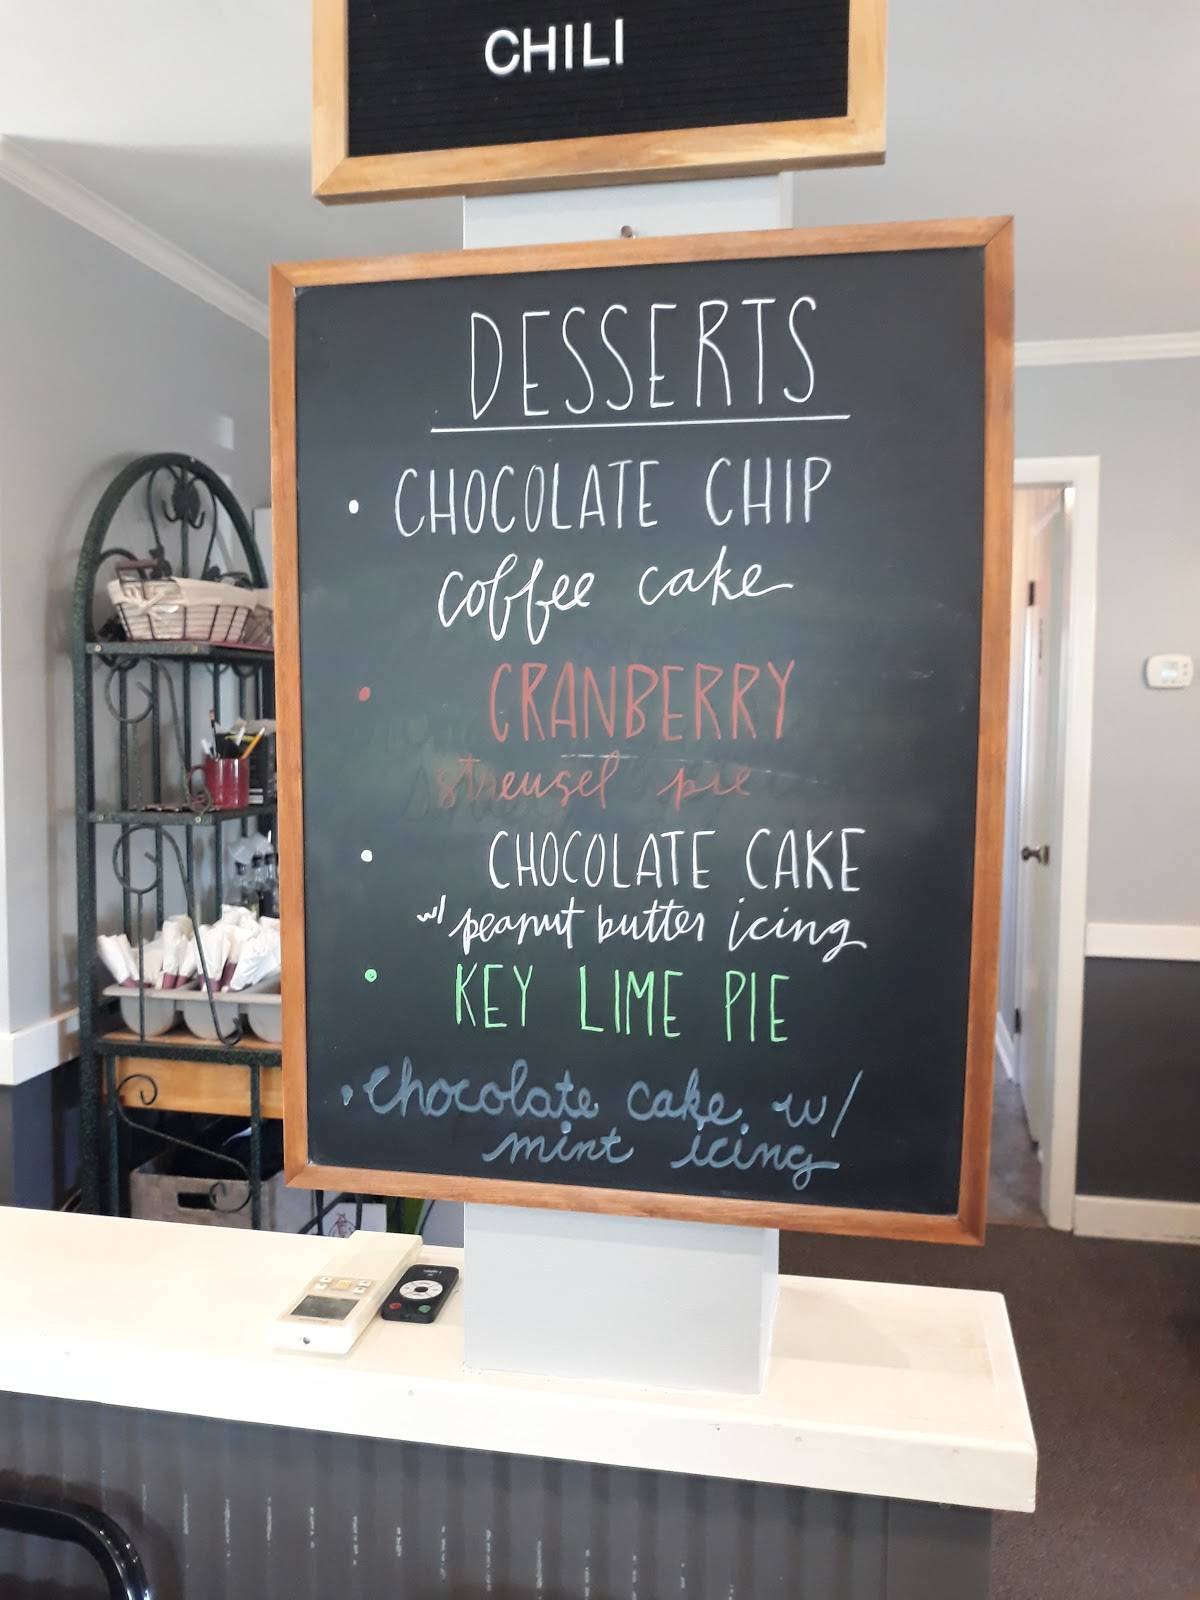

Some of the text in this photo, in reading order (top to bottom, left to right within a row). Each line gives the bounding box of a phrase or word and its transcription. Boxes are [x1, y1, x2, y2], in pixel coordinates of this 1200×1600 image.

[485, 19, 625, 76] CHILI
[470, 296, 818, 420] DESSERTS
[394, 456, 832, 537] CHOCOLATE CHIP
[437, 546, 794, 645] coffee cake
[488, 659, 795, 743] CRANBERRY
[657, 765, 751, 809] pie
[488, 828, 866, 893] CHOCOLATE CAKE
[417, 895, 867, 962] w/ peanut butter icing
[454, 963, 790, 1042] KEY LIME PIE
[771, 1070, 864, 1139] w/
[482, 1120, 841, 1191] mint icing
